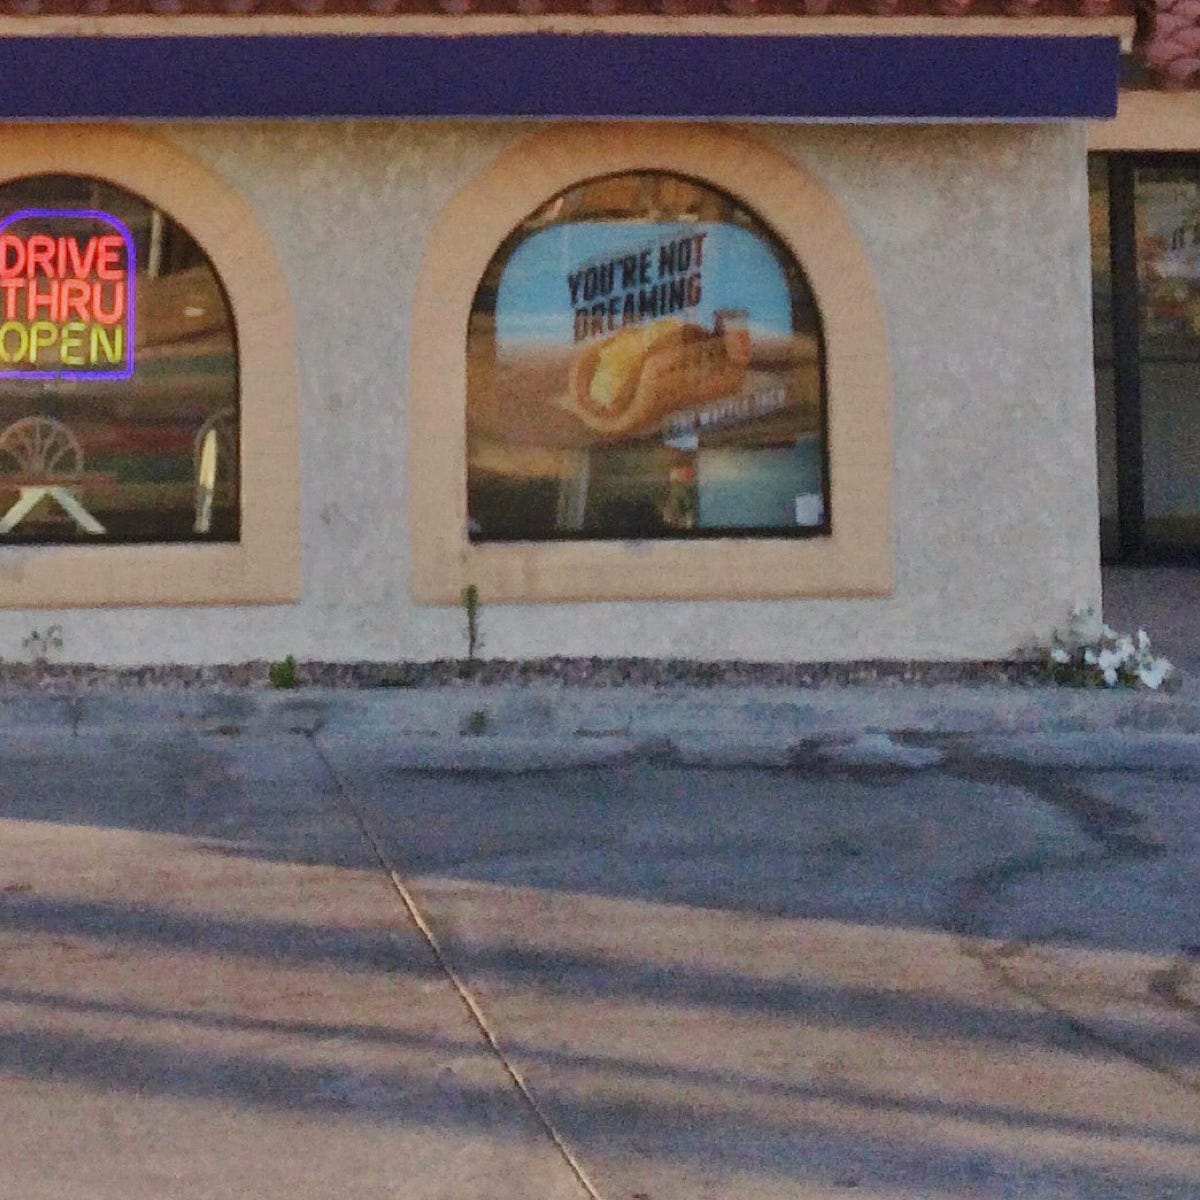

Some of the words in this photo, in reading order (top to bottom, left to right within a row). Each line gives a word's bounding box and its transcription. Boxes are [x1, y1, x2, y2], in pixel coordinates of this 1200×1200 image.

[658, 232, 708, 277] NOT
[0, 278, 125, 325] THRU
[574, 273, 702, 343] DREAMING
